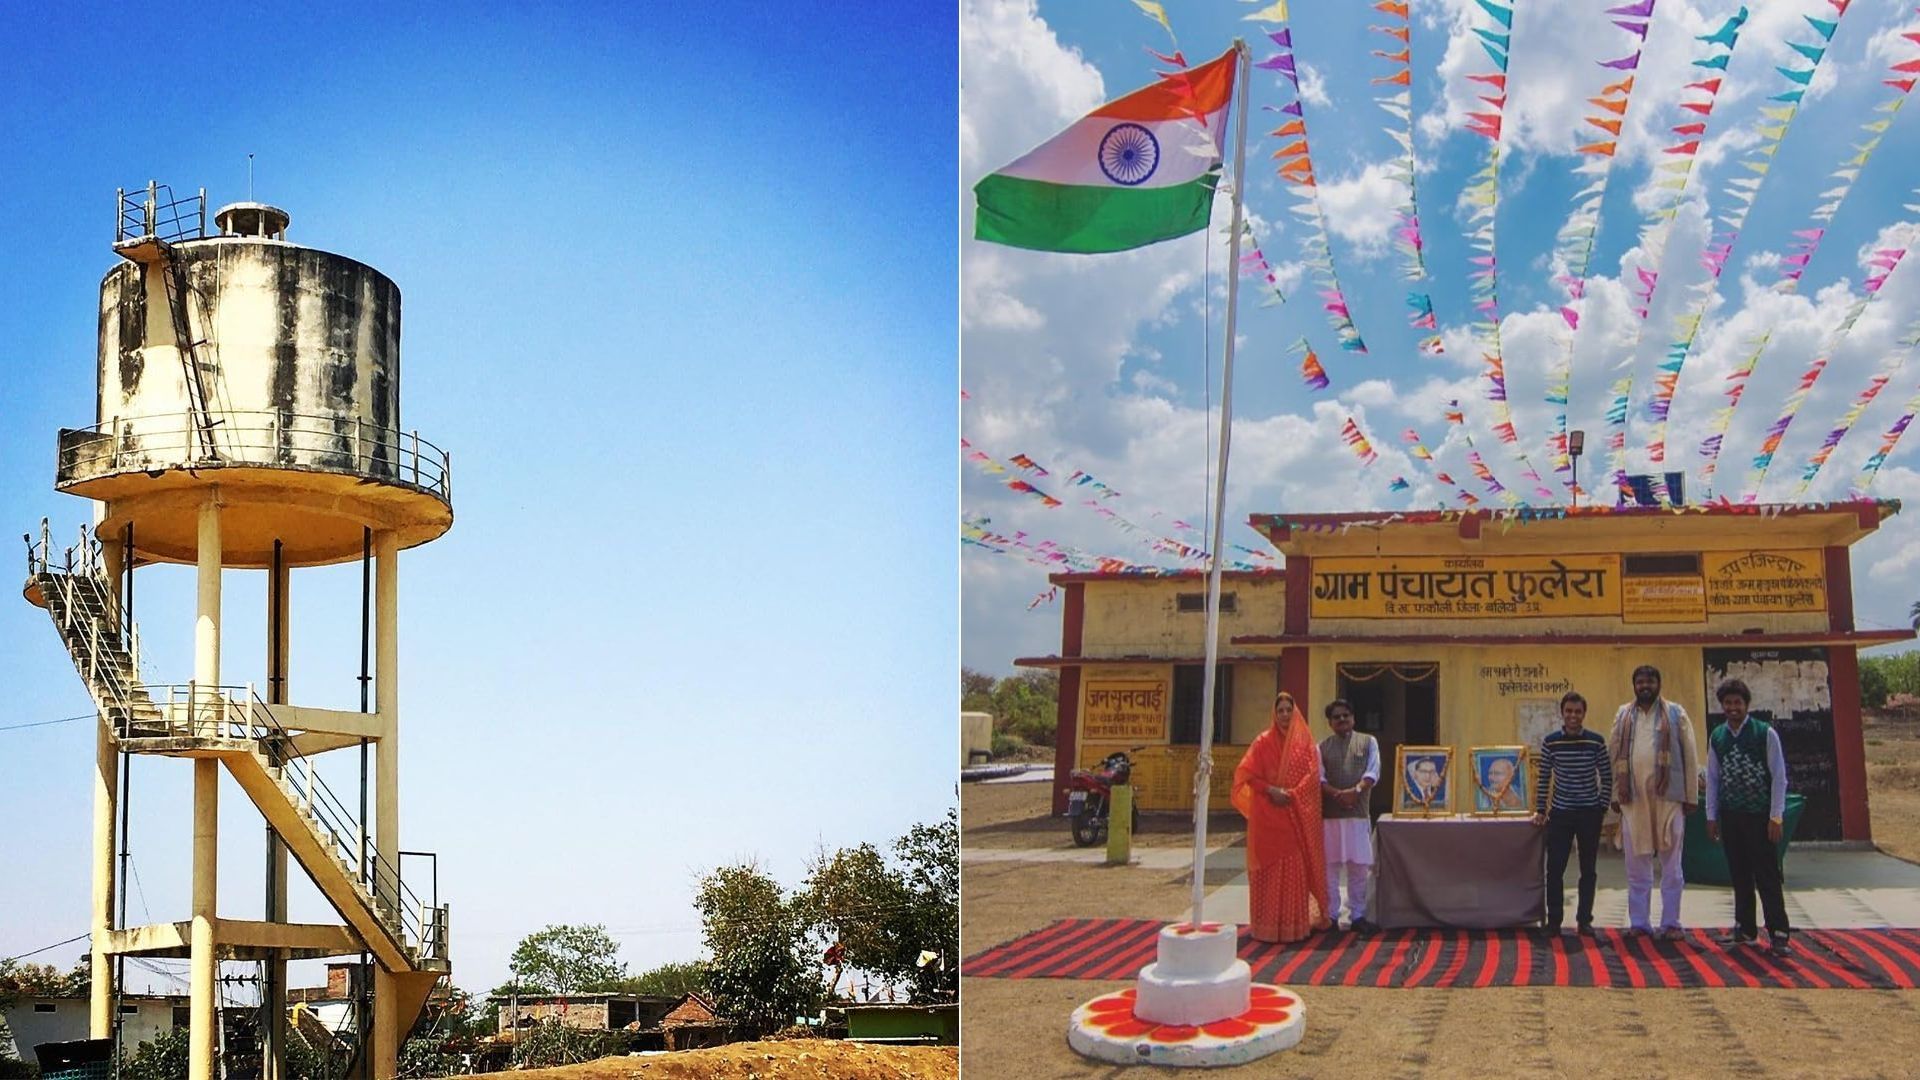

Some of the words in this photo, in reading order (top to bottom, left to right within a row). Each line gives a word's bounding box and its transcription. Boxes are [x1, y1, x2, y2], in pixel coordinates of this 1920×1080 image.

[1315, 572, 1371, 600] ग्राम
[1377, 564, 1497, 600] पंचायत
[1503, 559, 1606, 603] फुलेरा
